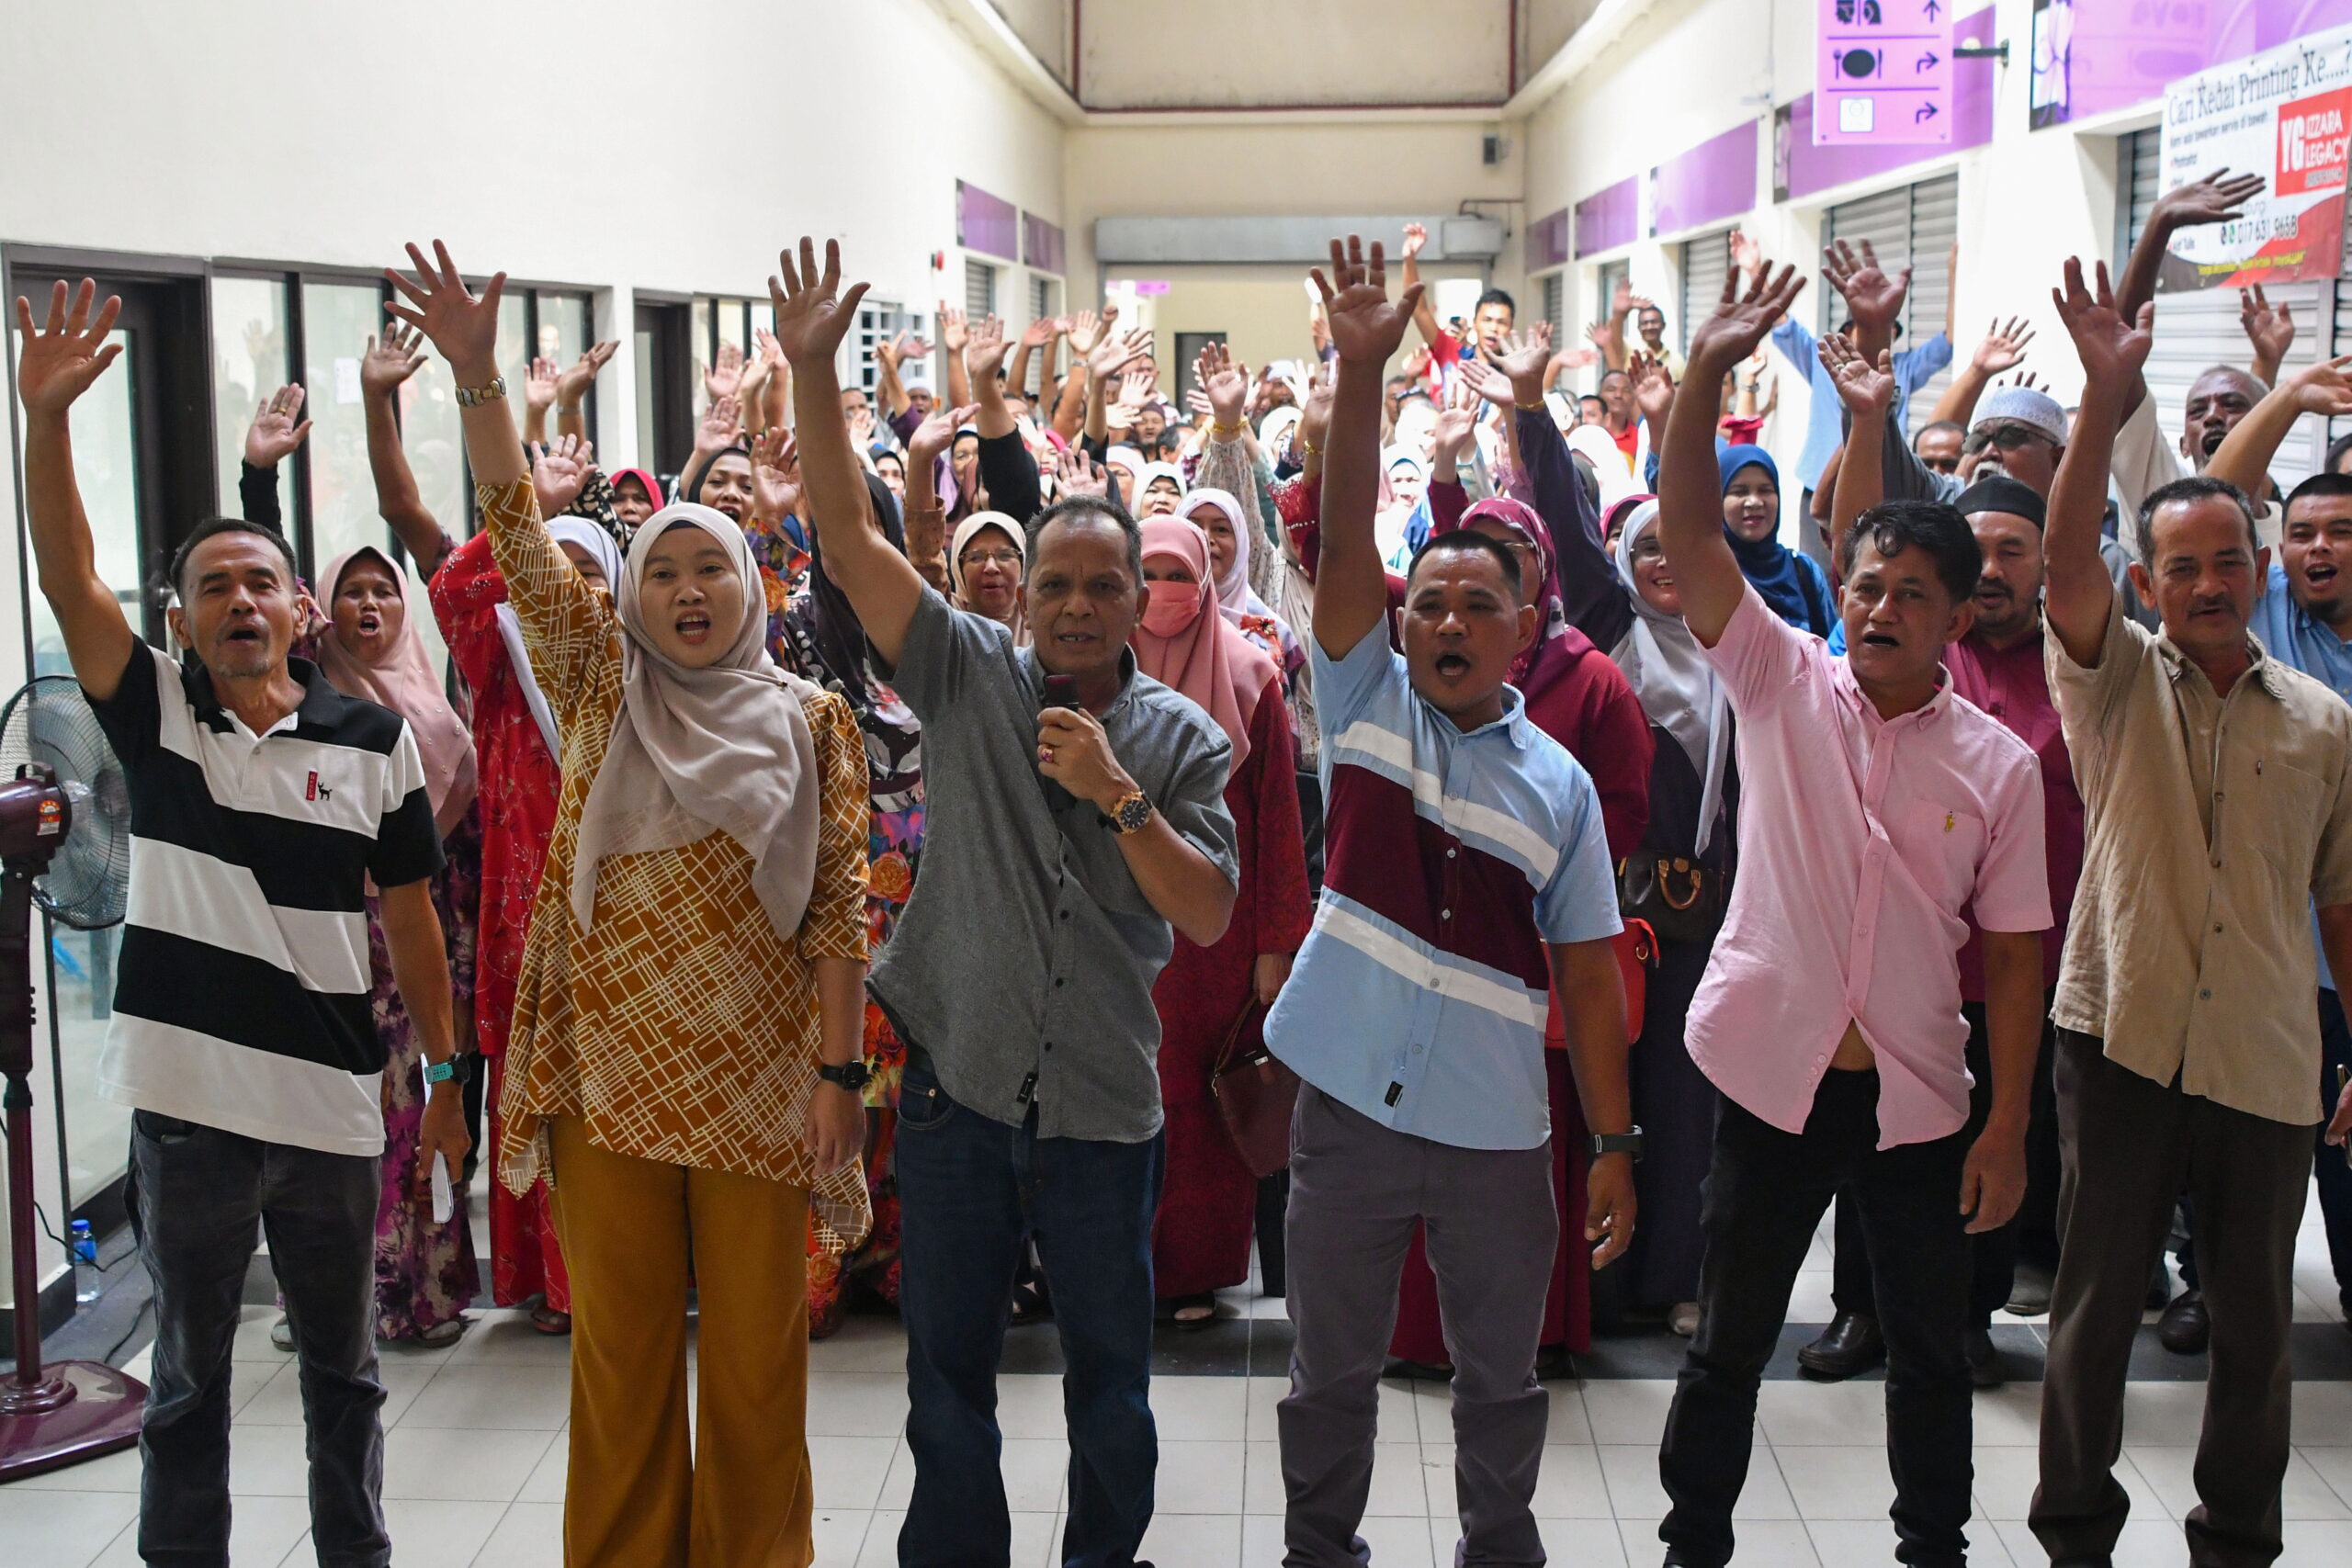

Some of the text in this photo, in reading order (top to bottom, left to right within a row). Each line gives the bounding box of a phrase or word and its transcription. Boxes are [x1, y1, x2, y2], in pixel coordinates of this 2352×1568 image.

[2169, 91, 2194, 126] Cari
[2197, 81, 2234, 118] Kedai
[2239, 64, 2300, 106] Printing
[2281, 114, 2305, 173] YG
[2306, 109, 2343, 139] IZZARA
[2305, 136, 2351, 168] LEGACY
